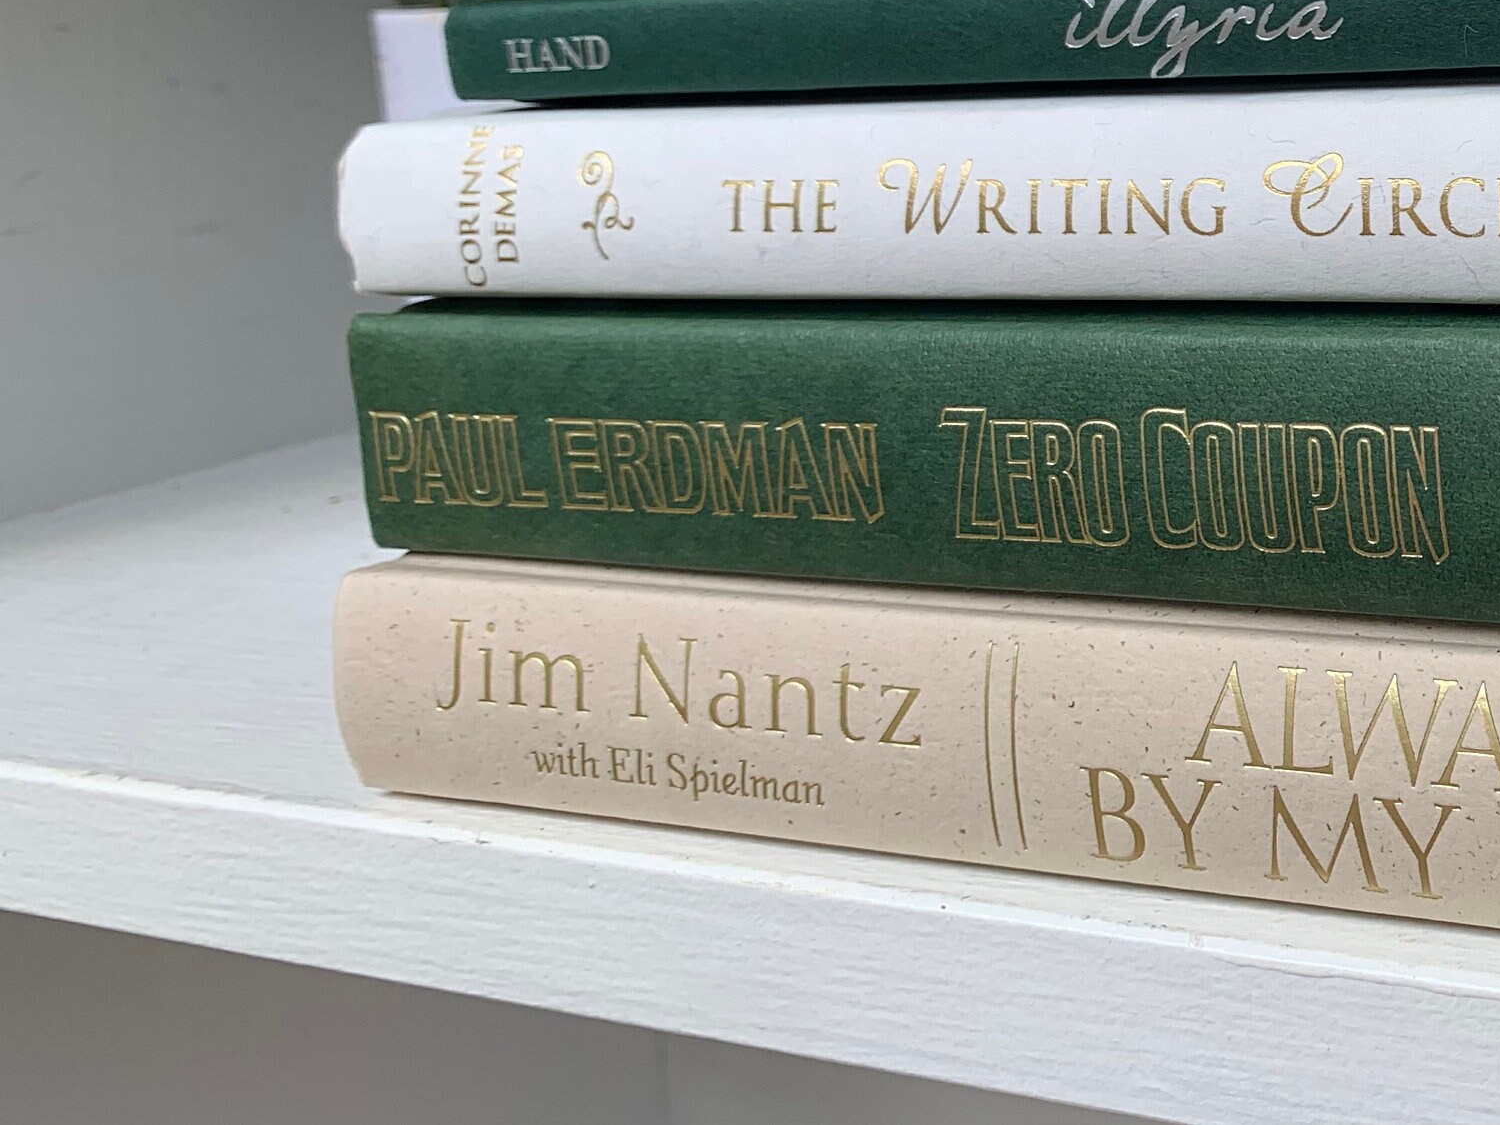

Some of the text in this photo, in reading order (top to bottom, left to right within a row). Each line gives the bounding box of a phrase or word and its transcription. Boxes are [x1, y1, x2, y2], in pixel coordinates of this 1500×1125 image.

[504, 35, 611, 73] HAND
[456, 124, 494, 288] CORINNE
[494, 143, 524, 264] DEMAS
[721, 178, 840, 233] THE
[368, 409, 884, 525] PAUL ERDMAN
[435, 618, 924, 748] Jim Nantz
[530, 745, 826, 807] with Eli Spielman
[1080, 766, 1222, 871] BY
[1268, 784, 1461, 900] MY
